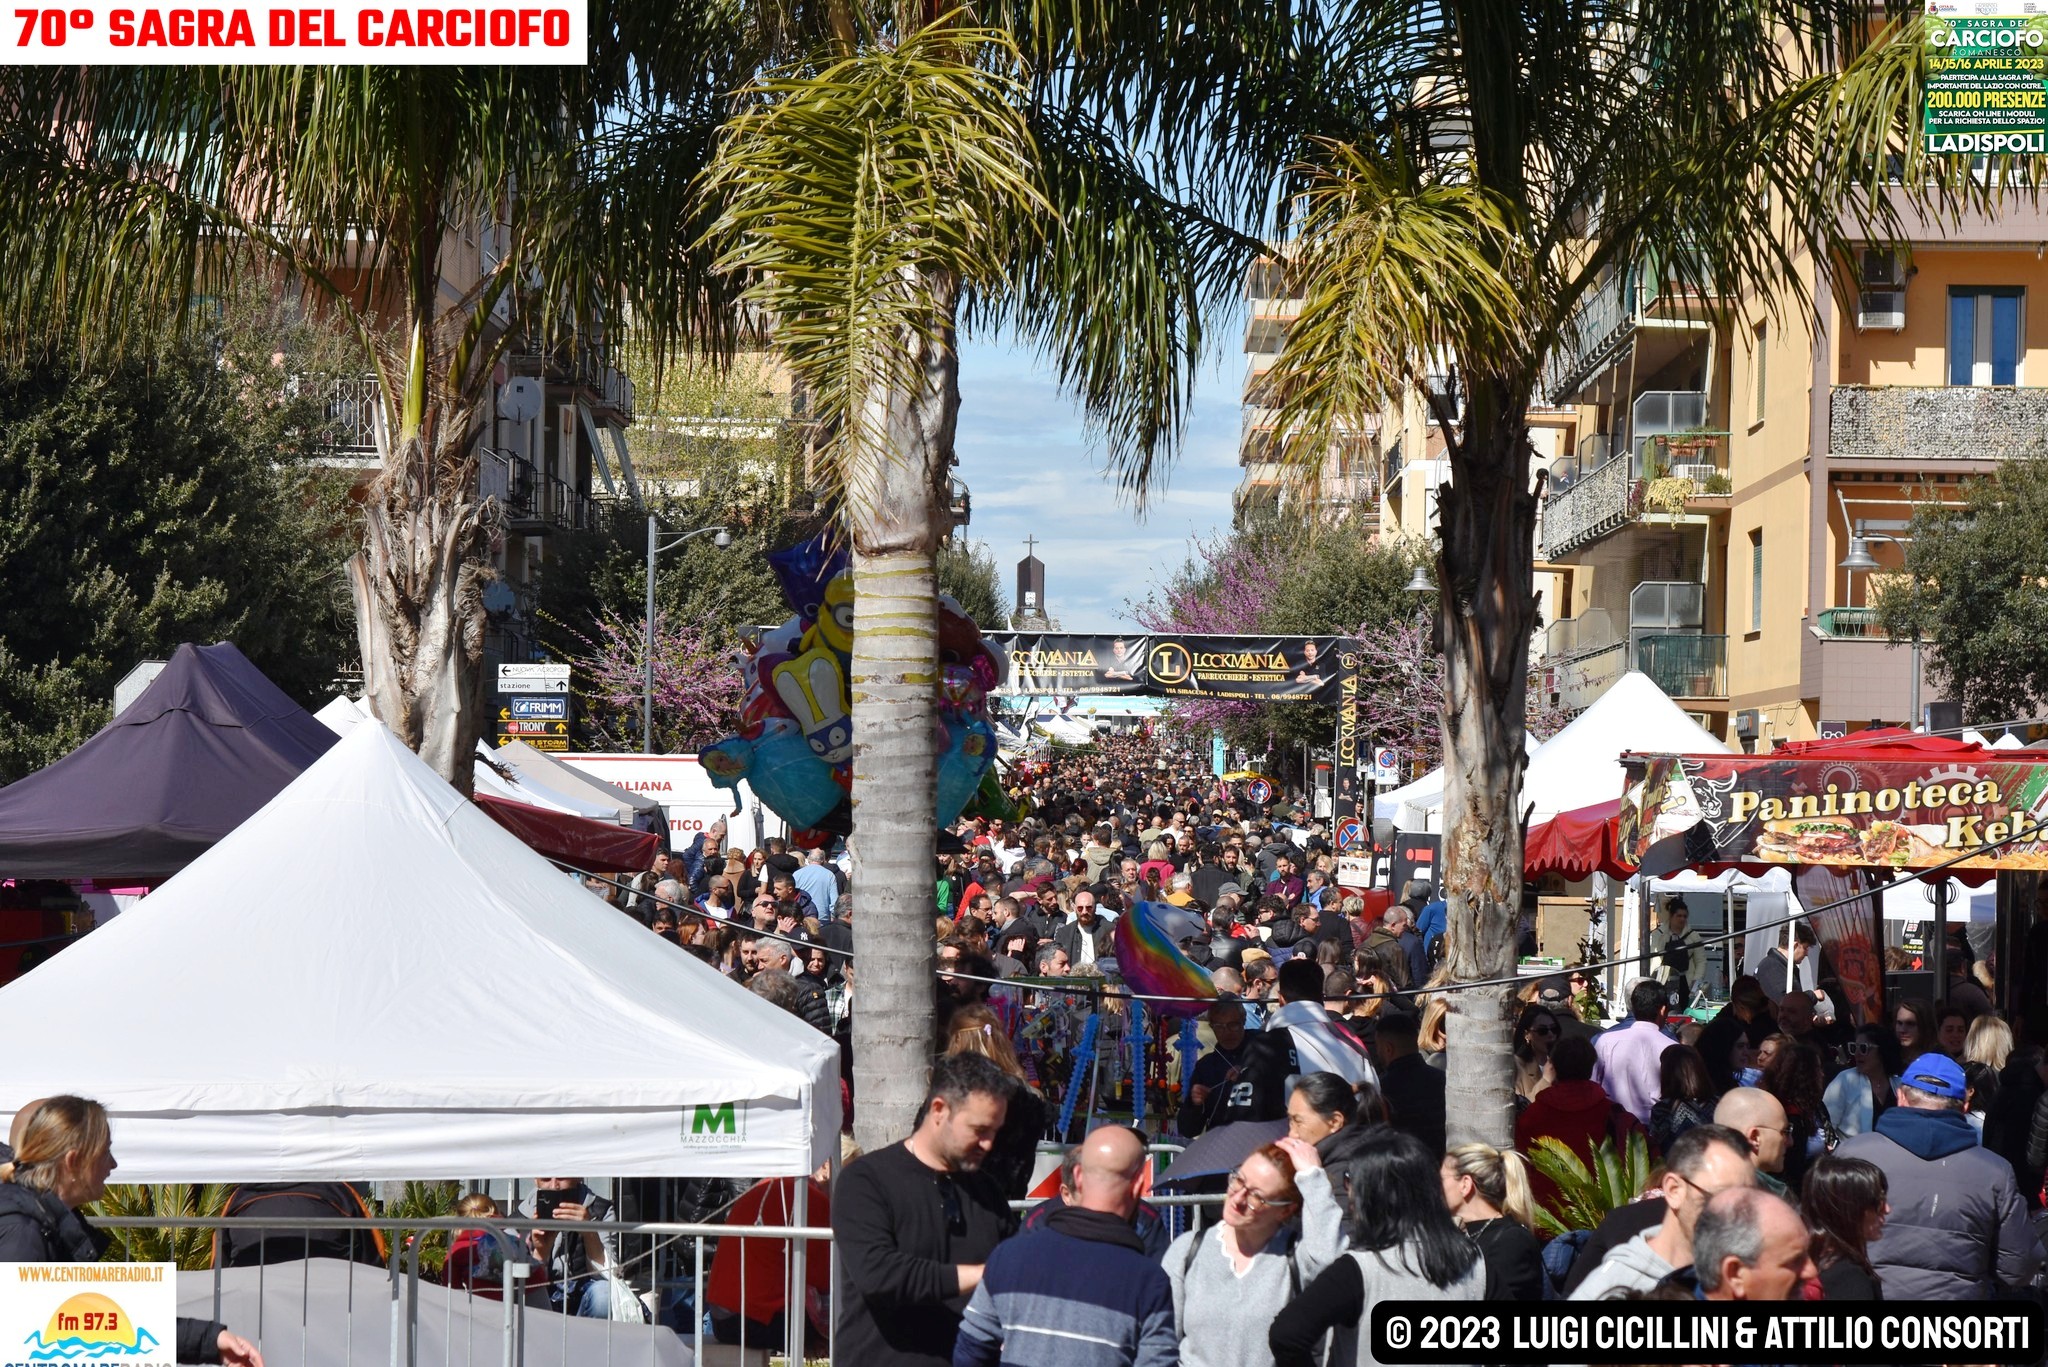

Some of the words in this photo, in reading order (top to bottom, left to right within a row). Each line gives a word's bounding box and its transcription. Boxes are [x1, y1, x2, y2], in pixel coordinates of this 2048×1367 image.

[1197, 672, 1249, 682] PARRUCCHIERE
[1252, 673, 1286, 682] ESTETICA
[1177, 688, 1208, 696] SIRACUSA
[1217, 691, 1250, 699] LADISPOLI
[529, 702, 562, 713] FRIMM
[519, 722, 546, 732] TRONY
[1727, 778, 2003, 824] Paninoteca
[691, 1102, 737, 1134] M
[680, 1135, 747, 1143] MAZZOCCHIA
